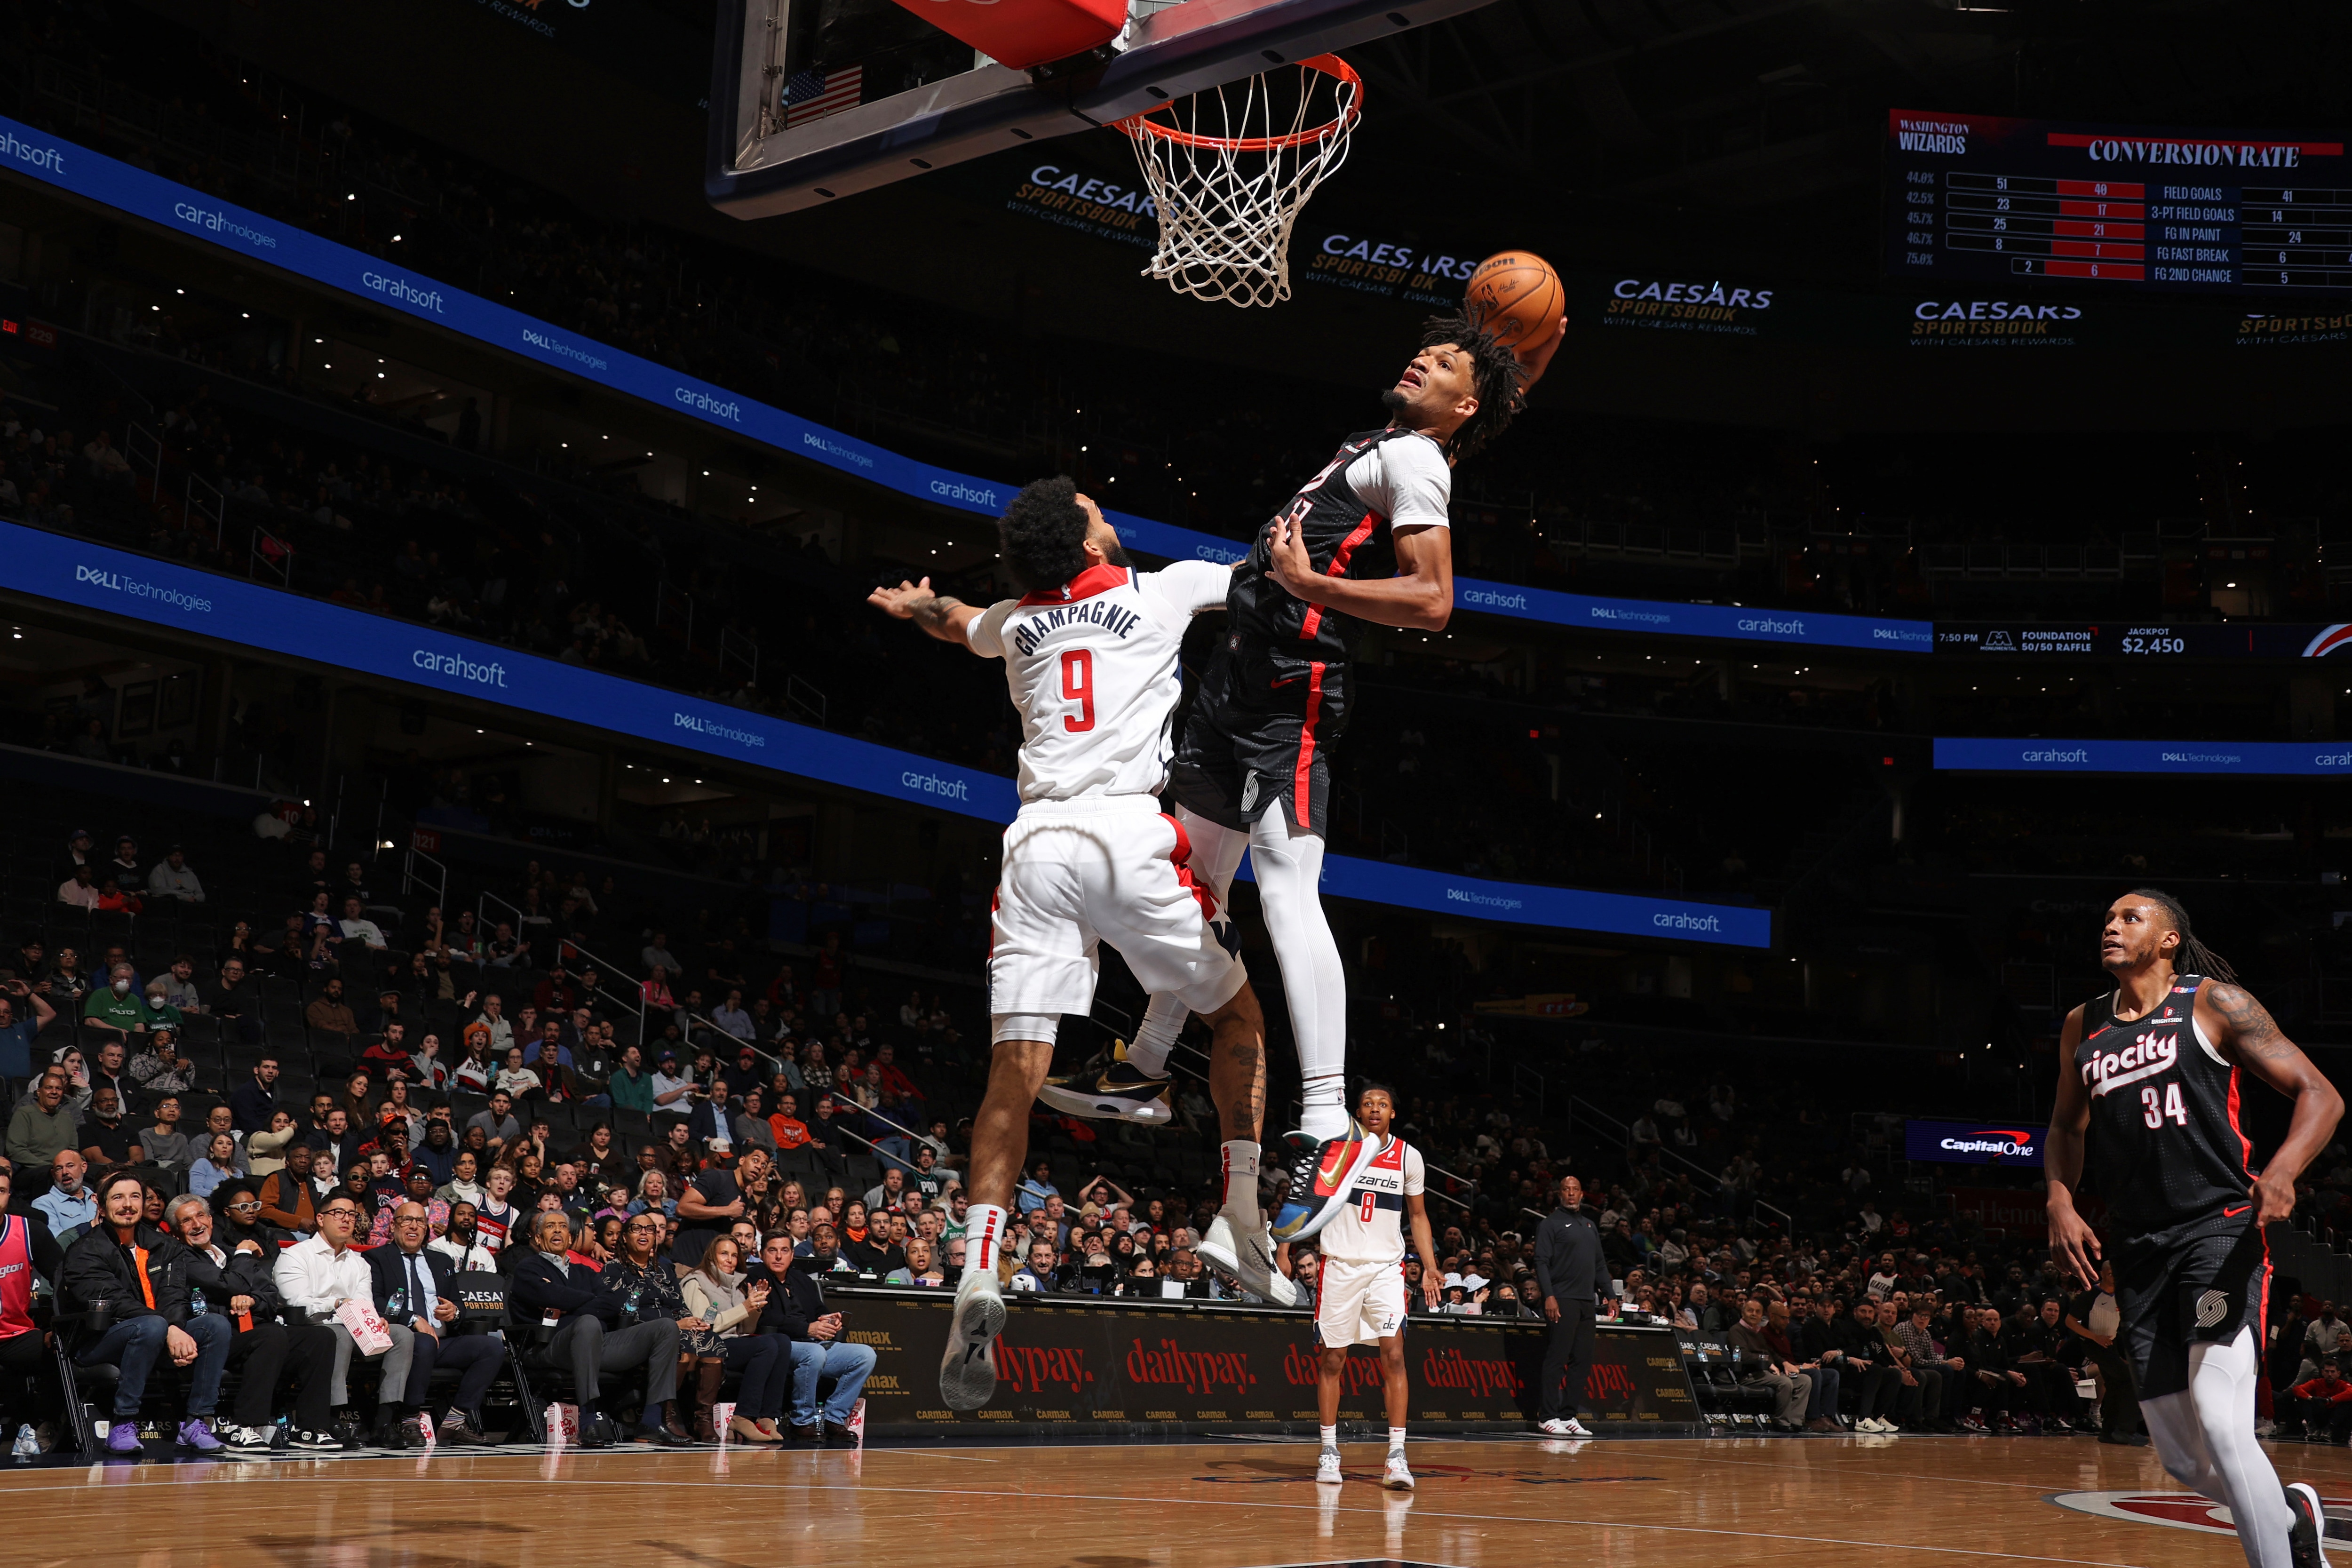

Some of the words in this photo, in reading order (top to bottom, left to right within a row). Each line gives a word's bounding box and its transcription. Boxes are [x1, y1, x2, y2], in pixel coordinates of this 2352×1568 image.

[1900, 119, 1970, 135] WASHINGTON
[1899, 131, 1966, 154] WIZARDS
[2089, 139, 2235, 166] CONVERSION
[2239, 146, 2300, 167] RATE
[1907, 171, 1934, 184] 44.0%
[1997, 178, 2008, 190] 51
[2095, 183, 2107, 195] 40
[2164, 186, 2188, 200] FIELD
[2191, 187, 2222, 201] GOALS
[1907, 192, 1934, 205] 42.5%
[2282, 191, 2293, 202] 41
[1016, 184, 1142, 230] SPORTSBOOK
[1997, 199, 2010, 210] 23
[2098, 204, 2107, 216] 17
[2151, 206, 2175, 220] 3-PT
[2176, 207, 2201, 221] FIELD
[2203, 208, 2234, 222] GOALS
[2272, 211, 2282, 222] 14
[1006, 200, 1038, 215] WITH
[1040, 209, 1094, 233] CAESARS
[1095, 227, 1158, 249] REWARDS
[1994, 218, 2007, 231] 25
[2094, 224, 2105, 236] 21
[2165, 226, 2177, 239] FG
[2179, 227, 2190, 240] IN
[2192, 228, 2221, 241] PAINT
[2289, 231, 2302, 244] 24
[1995, 239, 2003, 250] 8
[2095, 244, 2101, 256] 7
[2157, 247, 2169, 260] FG
[2171, 248, 2194, 261] FAST
[2196, 249, 2229, 263] BREAK
[2279, 251, 2287, 263] 6
[1311, 254, 1435, 290] SPORTSBOK
[2025, 261, 2033, 272] 2
[2091, 264, 2098, 276] 6
[2154, 267, 2167, 280] FG
[2169, 268, 2190, 281] 2ND
[2192, 269, 2232, 283] CHANCE
[2281, 272, 2288, 284] 5
[1305, 271, 1335, 286] WITH
[1336, 278, 1393, 295] CAESARS
[1403, 290, 1453, 308] EWARDS
[1609, 279, 1772, 310] CAESARS
[1606, 299, 1737, 321] SPORTSBOOK
[1914, 301, 2081, 320] CAESARS
[3, 319, 18, 334] EXIT
[1603, 317, 1636, 327] WITH
[1638, 319, 1694, 331] CAESARS
[1697, 323, 1757, 335] REWARDS
[1911, 321, 2049, 334] SPORTSBOOK
[30, 326, 53, 344] 229
[1909, 337, 1945, 346] WITH
[1947, 337, 2007, 346] CAESARS
[2011, 337, 2075, 346] REWARDS
[2234, 337, 2271, 346] WITH
[2279, 333, 2348, 344] CAESARS
[522, 329, 551, 350] DELL
[551, 339, 607, 371] Technologies
[804, 433, 828, 452] DELL
[828, 441, 873, 468] Technologies
[76, 565, 121, 590] DELL
[122, 574, 212, 612] Technologies
[1591, 607, 1618, 619] DELL
[1015, 601, 1141, 657] CHAMPAGNIE
[1873, 629, 1899, 640] DELL
[2022, 631, 2090, 641] FOUNDATION
[2127, 628, 2170, 636] JACKPOT
[1939, 633, 1961, 642] 7:50
[1963, 634, 1979, 642] PM
[2021, 643, 2053, 653] 50/50
[2056, 643, 2091, 652] RAFFLE
[2122, 636, 2185, 655] $2,450
[1061, 649, 1096, 732] 9
[674, 712, 706, 732] DELL
[705, 719, 765, 747] Technologies
[2162, 753, 2188, 762] DELL
[2187, 753, 2241, 764] Technologies
[283, 809, 300, 824] 10
[415, 836, 434, 849] 121
[1447, 888, 1470, 902] DELL
[2081, 1030, 2177, 1092] ripcity
[2140, 1082, 2187, 1130] 34
[1940, 1138, 2004, 1154] Capital
[2003, 1142, 2034, 1157] One
[1360, 1191, 1376, 1223] 8
[1979, 1200, 2047, 1224] Henne
[481, 1235, 488, 1248] 4
[459, 1290, 503, 1302] CAESA
[1383, 1317, 1396, 1329] dc
[993, 1333, 1094, 1393] lypay.
